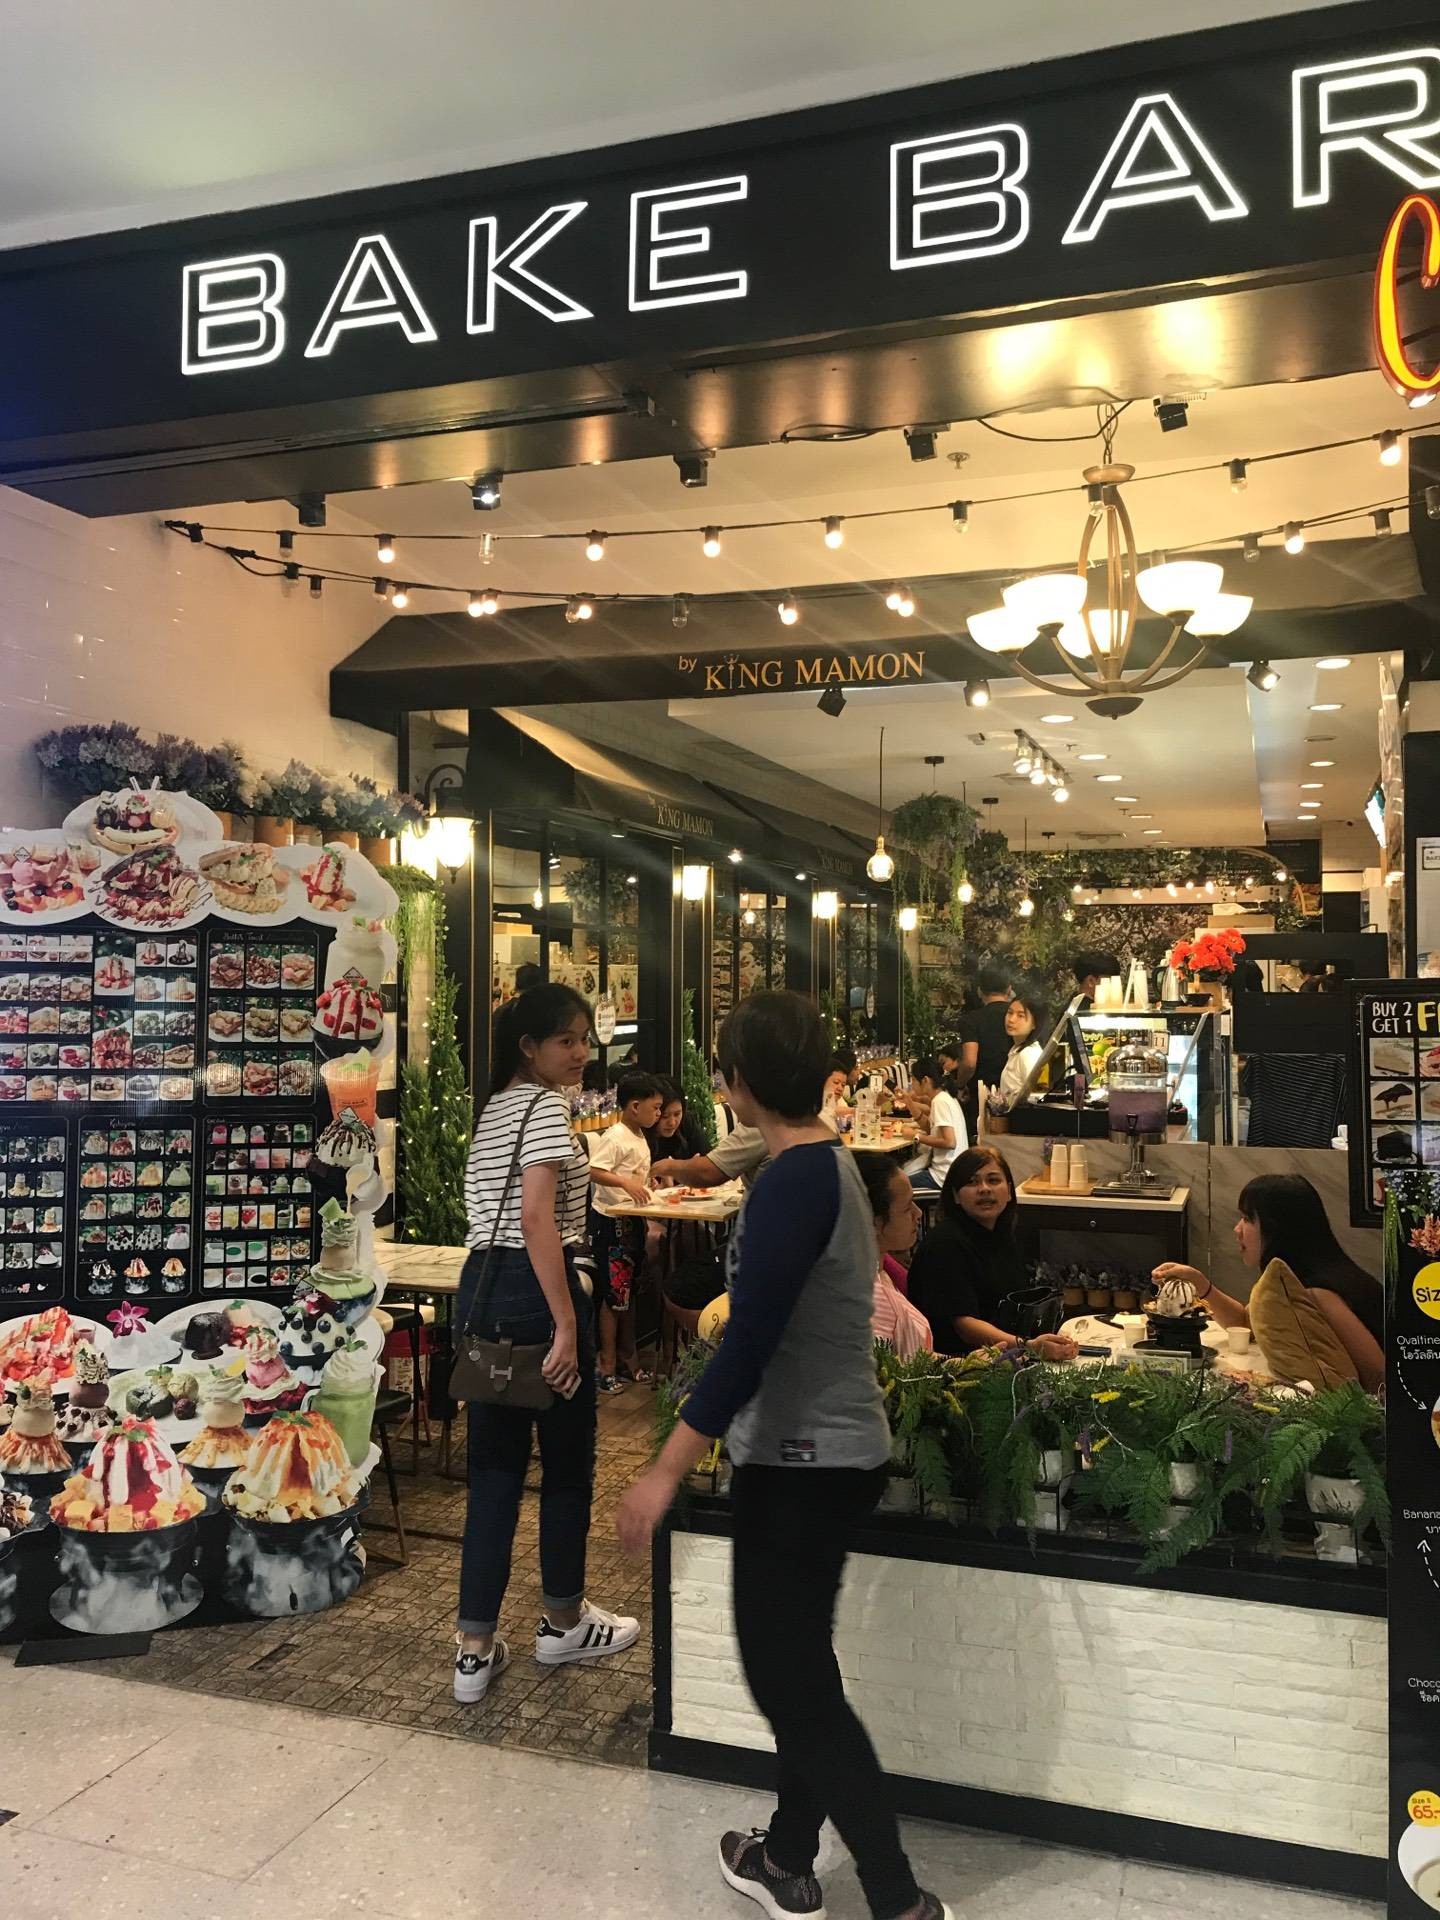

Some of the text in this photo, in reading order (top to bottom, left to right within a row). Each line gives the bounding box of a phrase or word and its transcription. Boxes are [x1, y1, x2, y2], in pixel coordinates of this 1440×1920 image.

[181, 48, 1440, 376] BAKE BAR
[678, 651, 925, 690] by KING MAMON
[657, 804, 713, 837] KING MAMON
[1372, 1001, 1413, 1017] BUY 2
[1372, 1017, 1412, 1034] GET 1
[1397, 1335, 1440, 1345] Ovaltine
[1403, 1509, 1440, 1519] Banana
